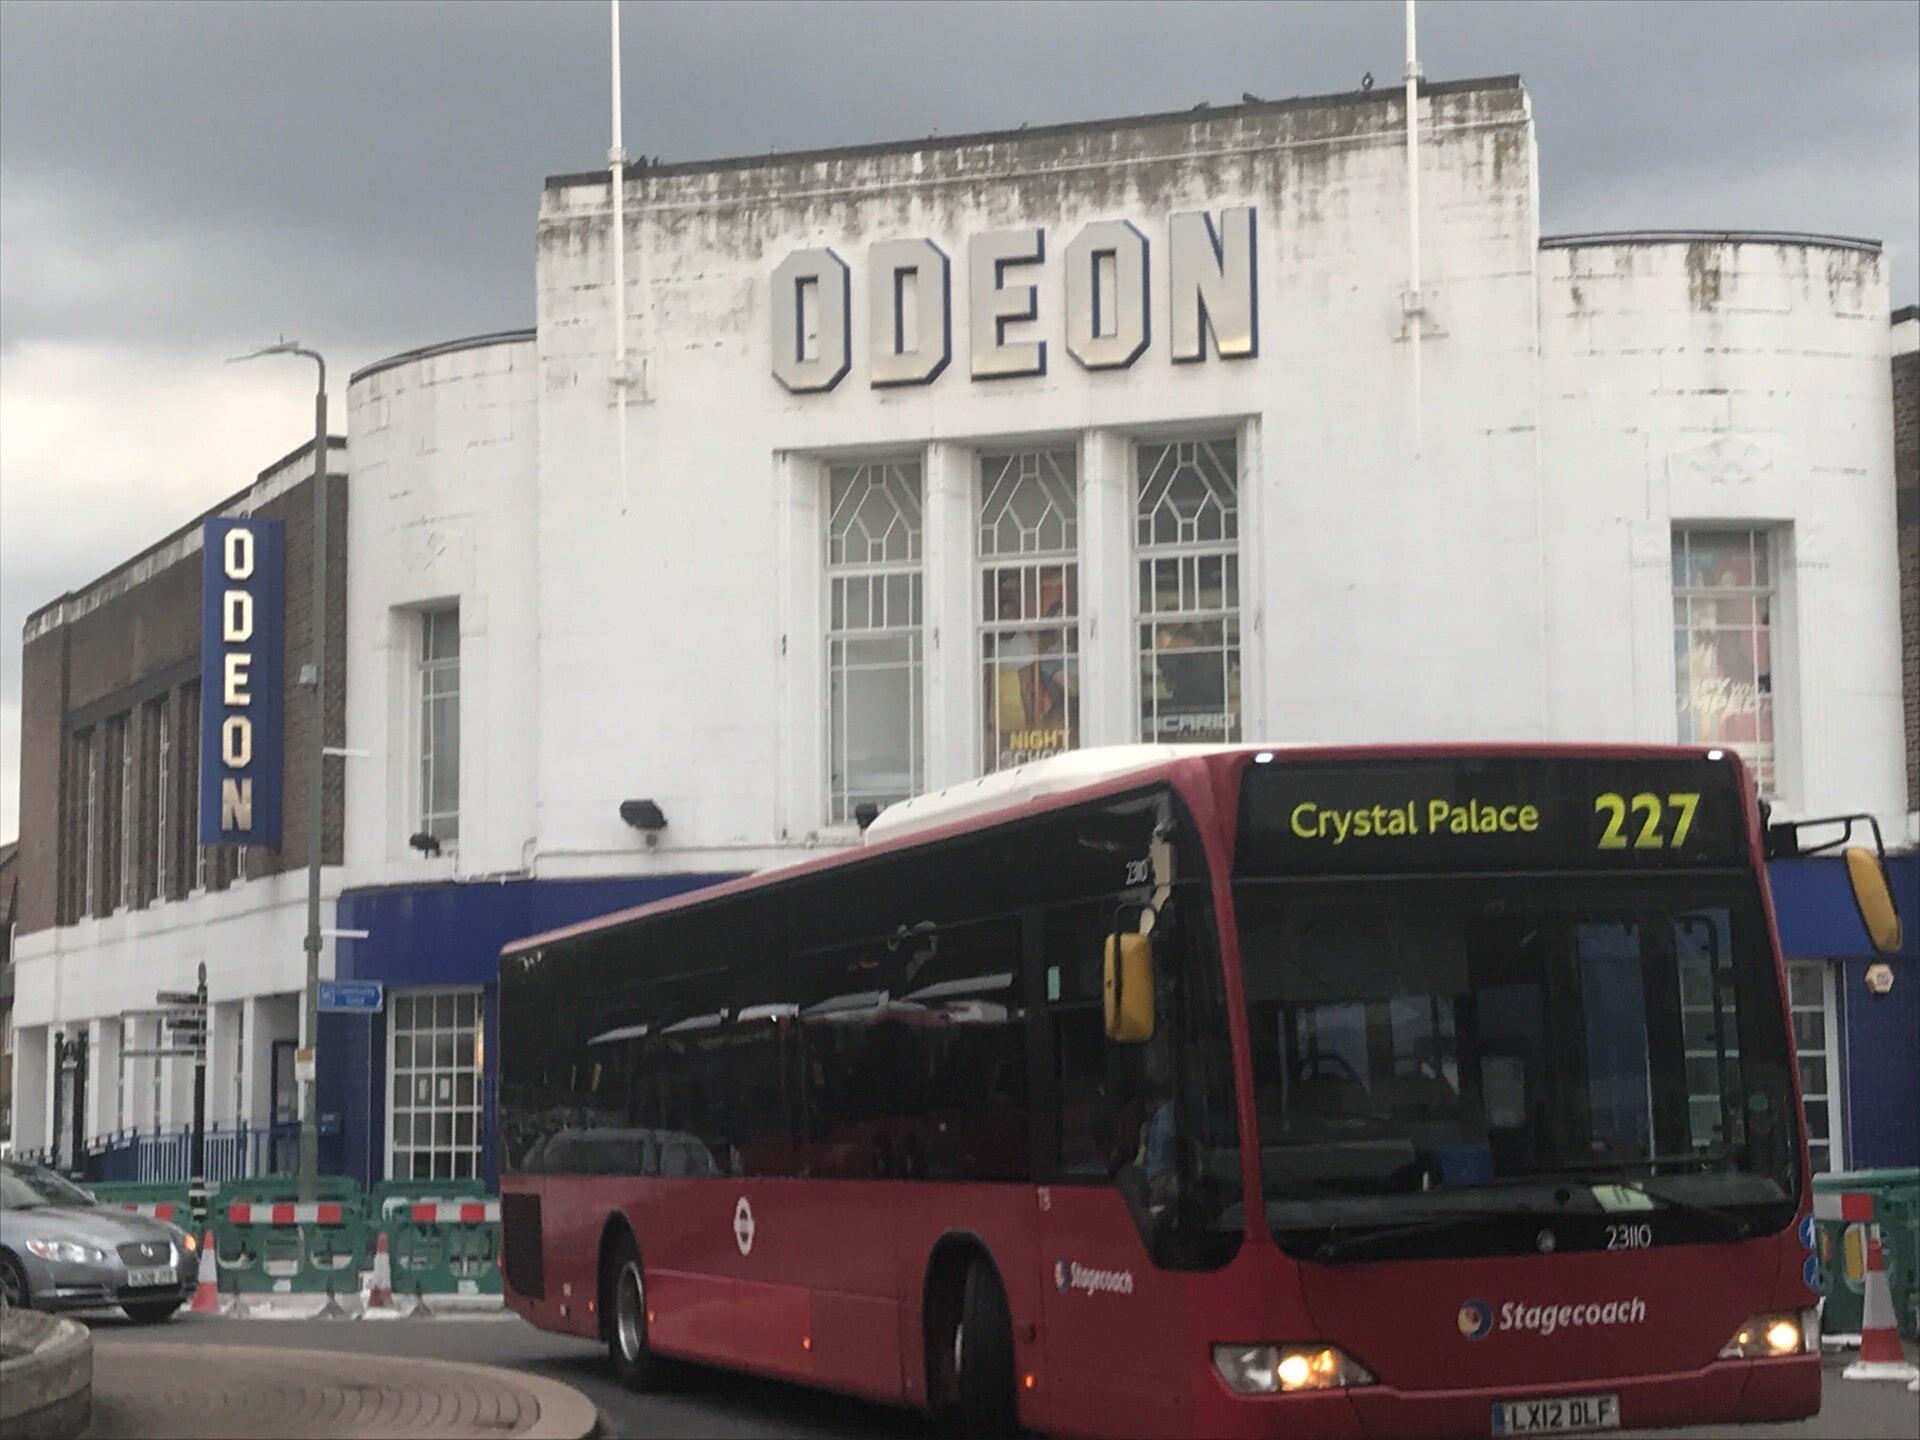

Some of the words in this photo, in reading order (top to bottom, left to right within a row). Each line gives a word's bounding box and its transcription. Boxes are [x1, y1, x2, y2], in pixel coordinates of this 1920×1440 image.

[771, 206, 1259, 394] ODEON
[221, 527, 254, 832] ODEON
[1009, 729, 1071, 749] NIGHT
[1291, 801, 1417, 845] Crystal
[1428, 799, 1539, 834] Palace
[1594, 793, 1700, 849] 227
[1605, 1223, 1652, 1250] 23110
[1071, 1261, 1133, 1296] Stagecoach
[1500, 1297, 1647, 1336] Stagecoach
[1511, 1402, 1563, 1430] LX12
[1569, 1399, 1611, 1426] DLF
